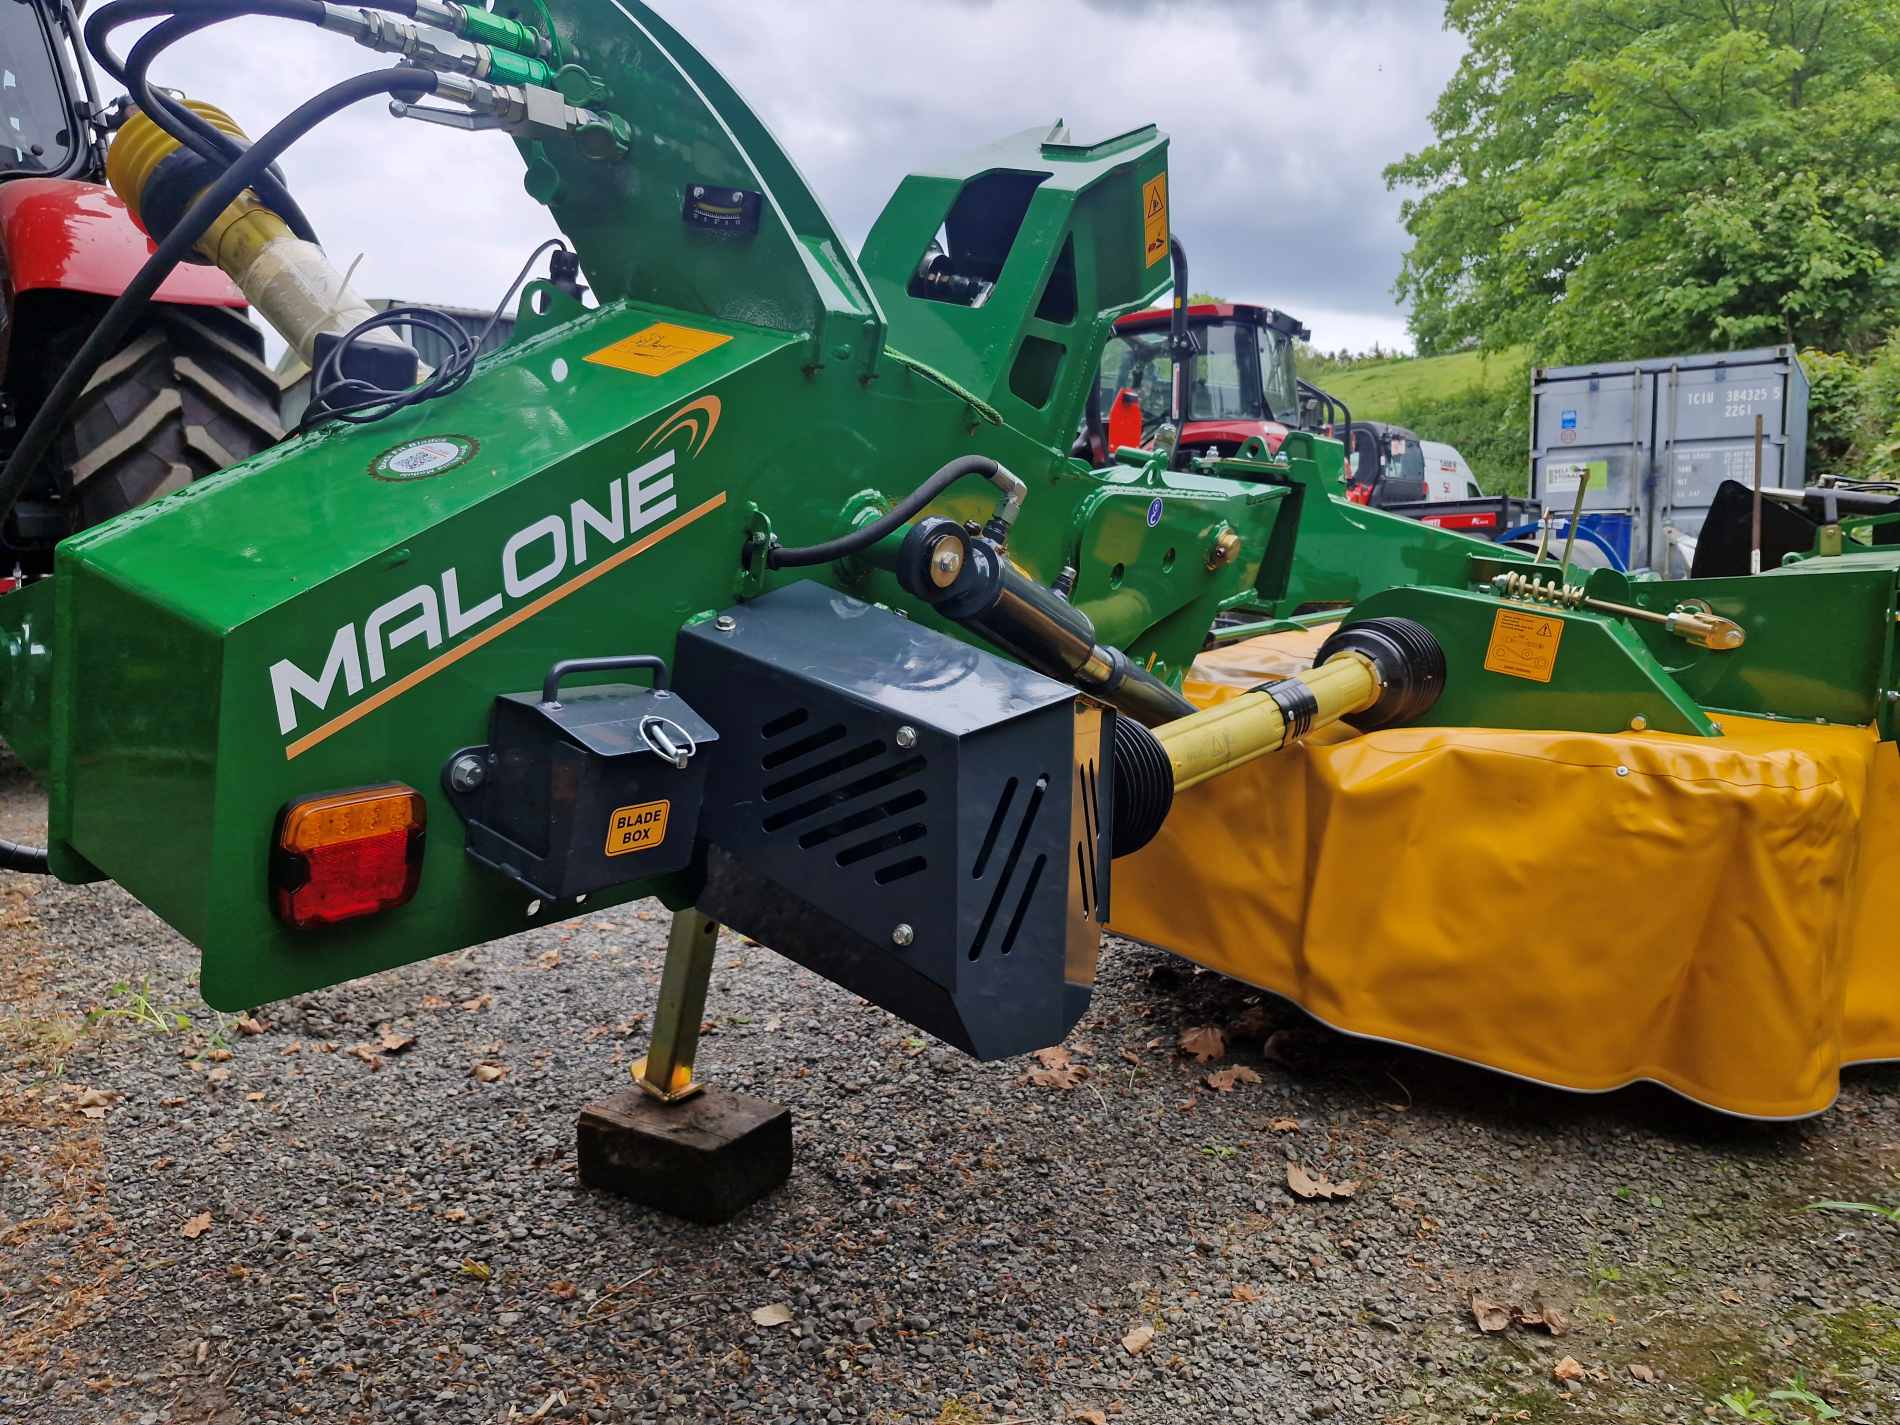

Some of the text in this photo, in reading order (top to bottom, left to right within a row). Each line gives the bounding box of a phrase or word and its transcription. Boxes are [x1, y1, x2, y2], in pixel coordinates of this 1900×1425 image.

[1688, 386, 1781, 406] TCIU 384325 5
[1725, 404, 1752, 417] 22G1
[269, 449, 677, 735] MALONE
[617, 809, 662, 829] BLADE
[622, 828, 651, 845] BOX
